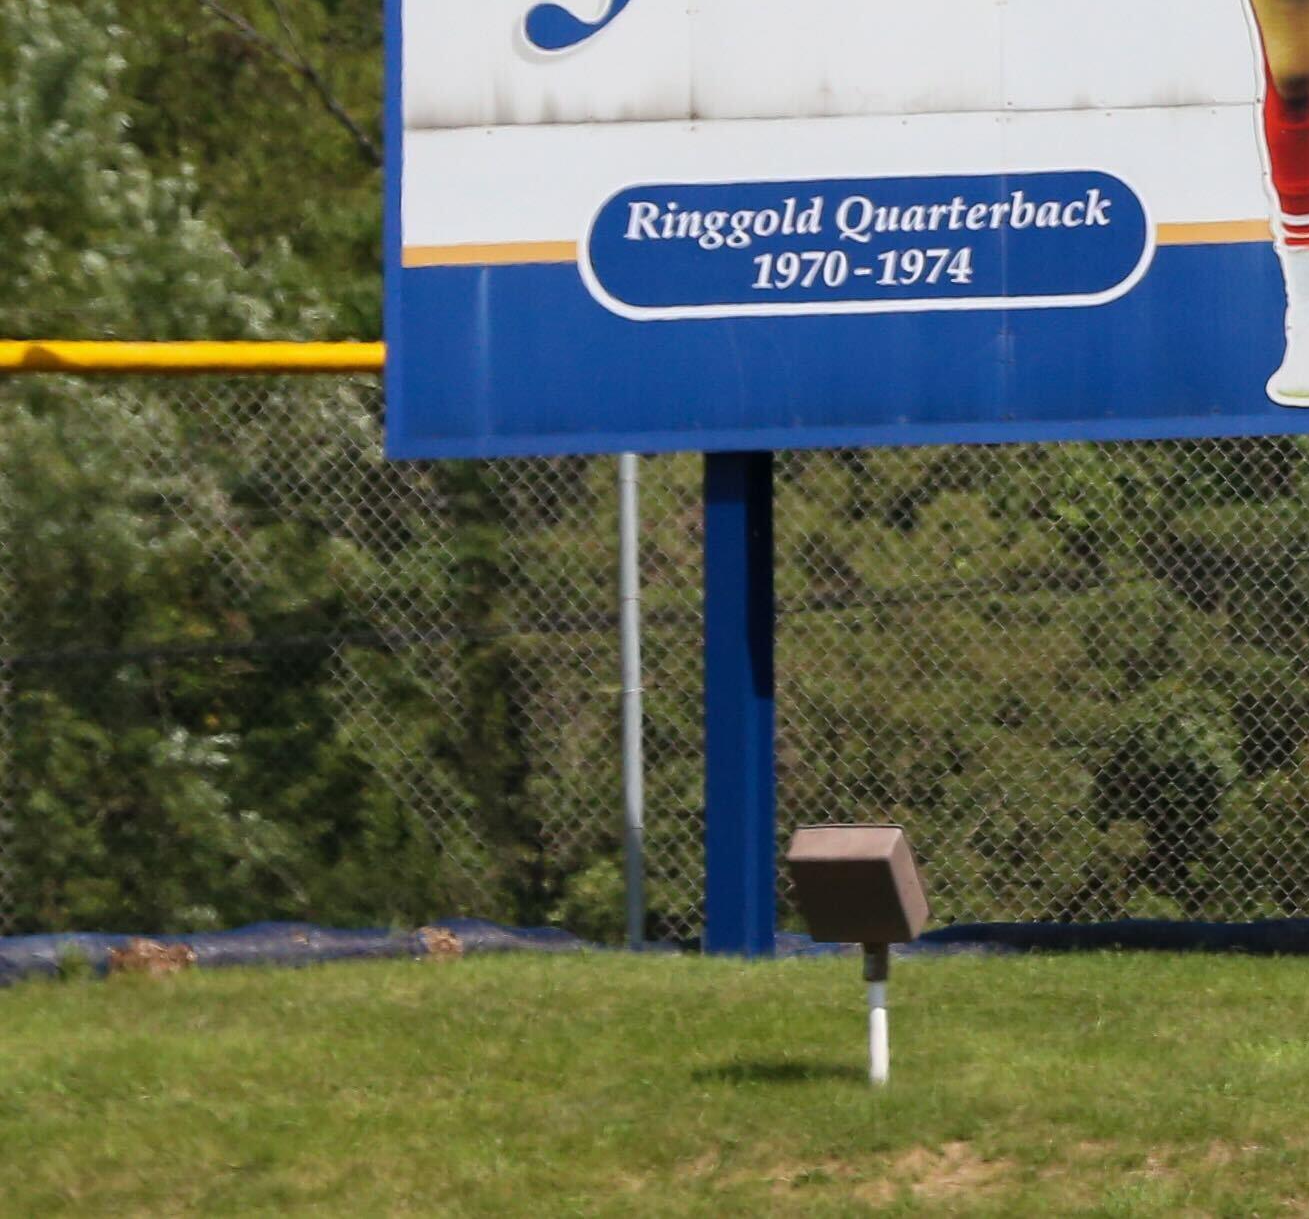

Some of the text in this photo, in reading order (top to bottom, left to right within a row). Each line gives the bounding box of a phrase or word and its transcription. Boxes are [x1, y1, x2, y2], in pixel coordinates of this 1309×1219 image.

[623, 188, 1112, 249] Ringgold Quarterback
[751, 246, 974, 290] 1970-1974
